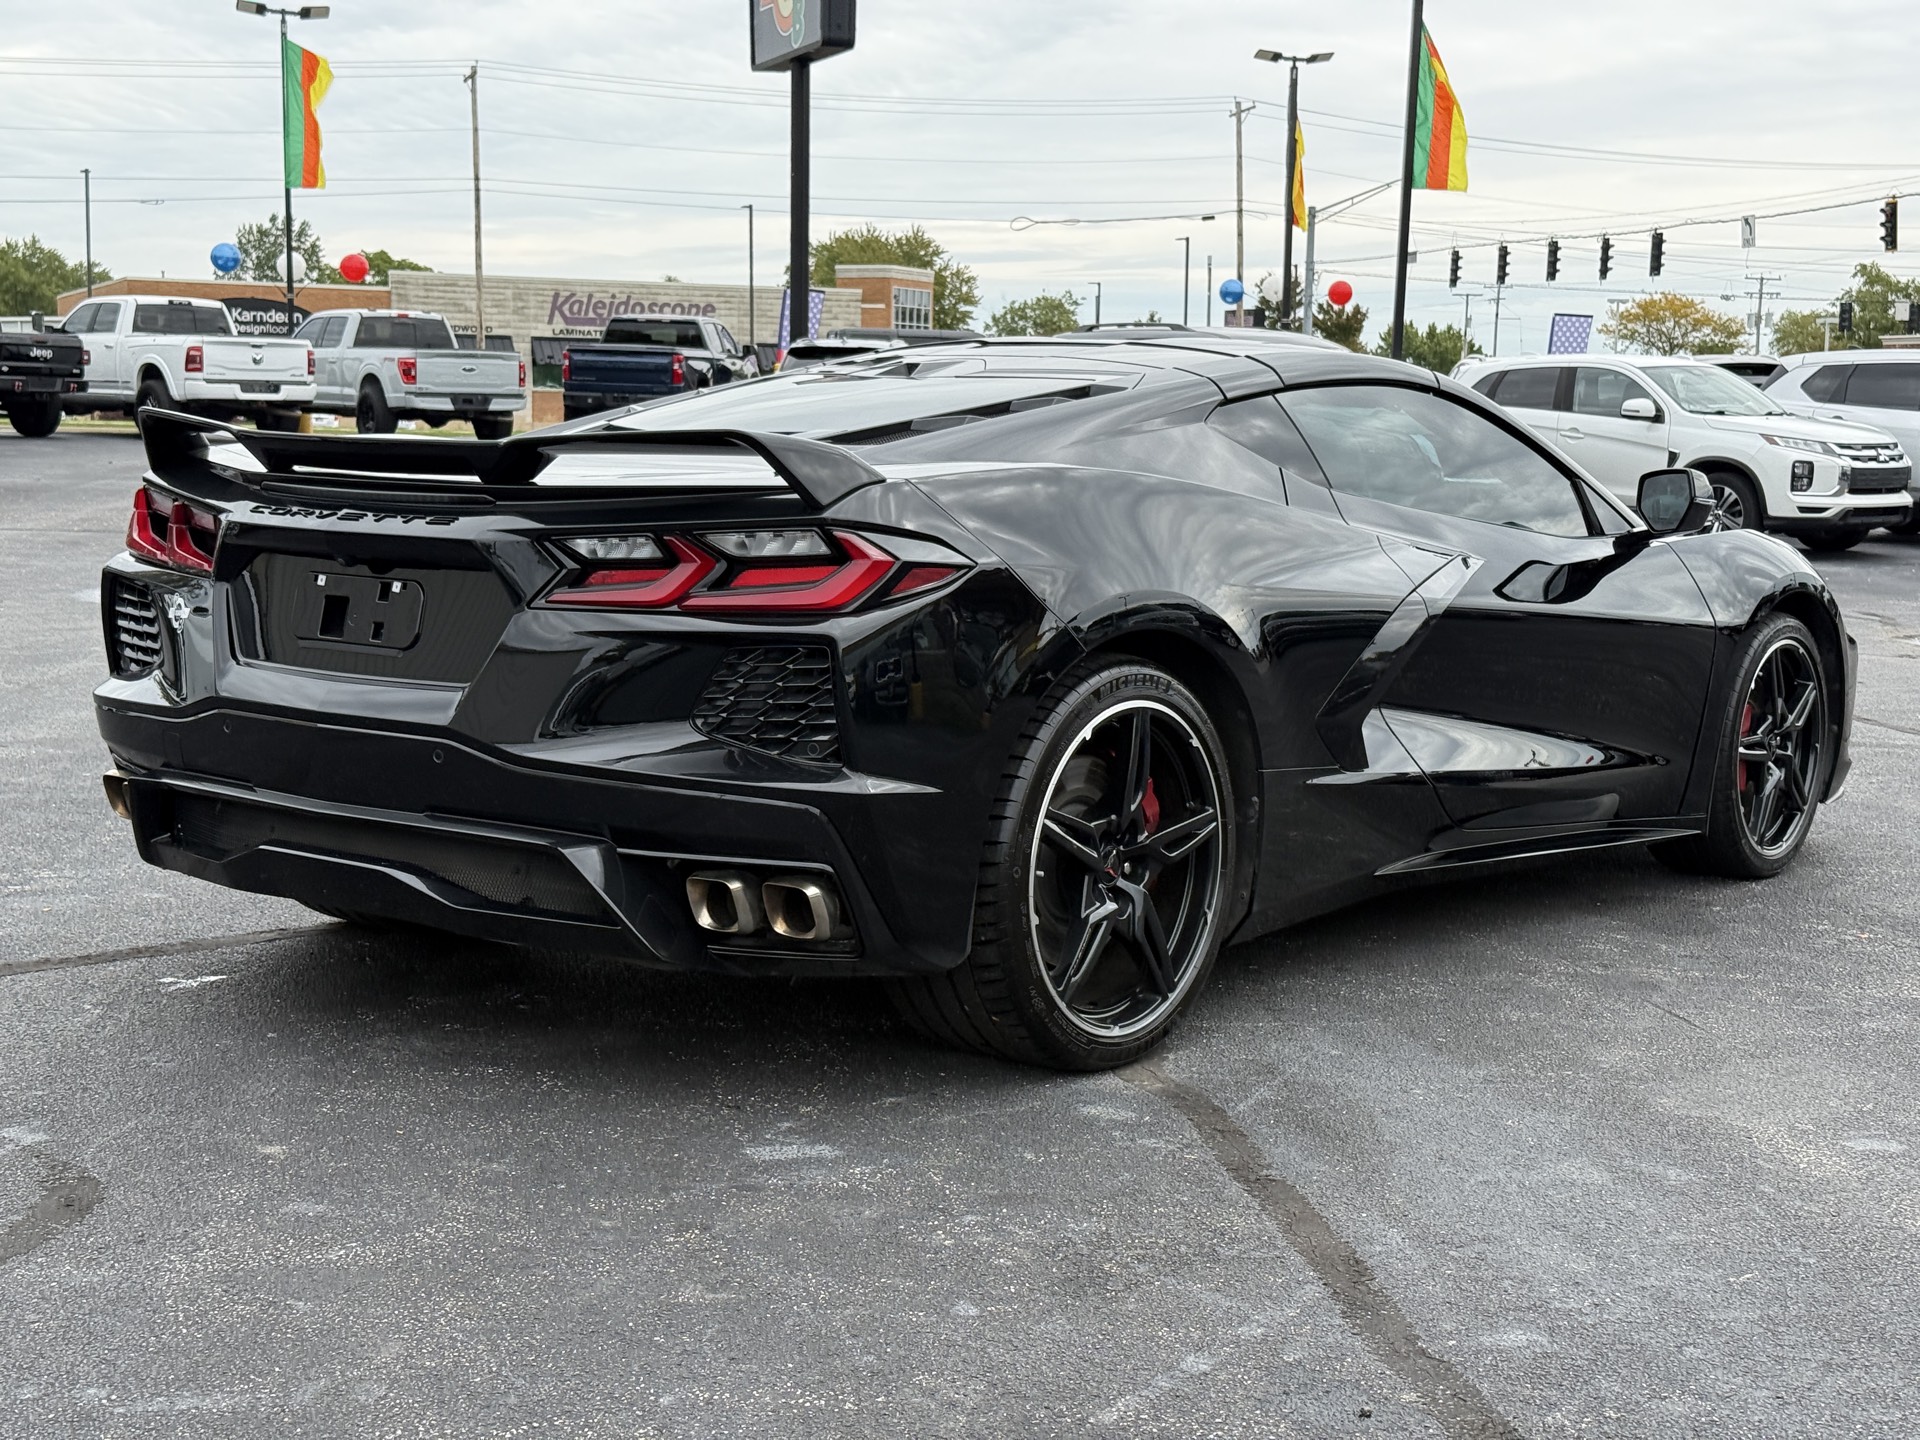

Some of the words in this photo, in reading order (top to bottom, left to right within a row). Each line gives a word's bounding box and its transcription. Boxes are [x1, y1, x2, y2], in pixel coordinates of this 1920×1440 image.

[233, 323, 299, 335] Designfloor
[30, 346, 53, 359] Jeep
[249, 504, 460, 526] CORVETTE
[1098, 673, 1172, 701] MICHELIN
